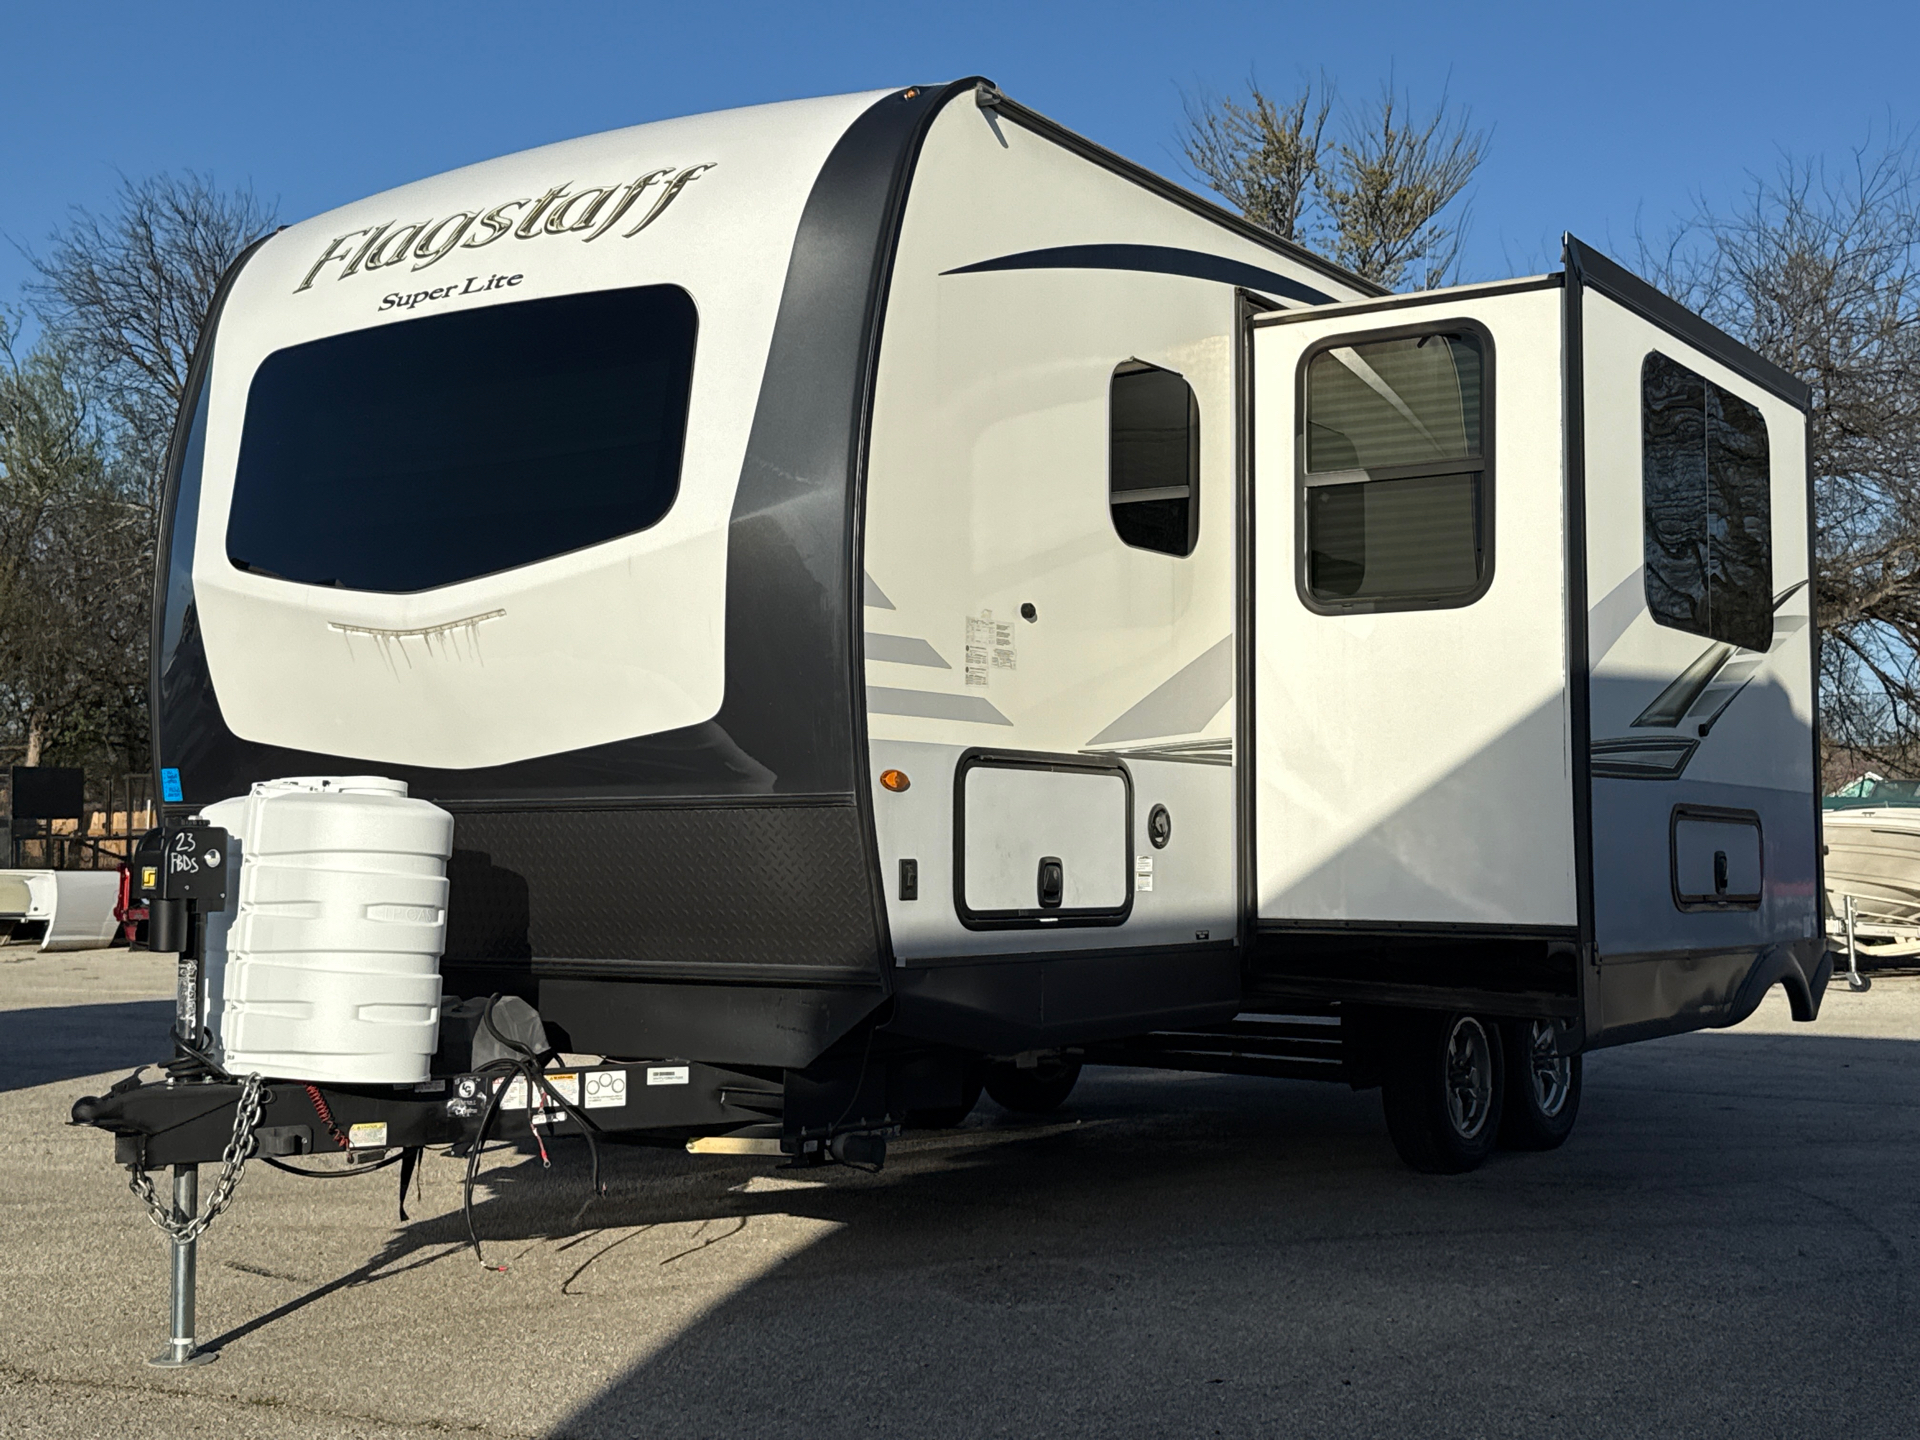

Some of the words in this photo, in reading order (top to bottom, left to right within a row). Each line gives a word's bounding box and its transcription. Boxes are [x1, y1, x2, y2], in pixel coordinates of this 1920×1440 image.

[292, 161, 718, 295] Flagstaff
[377, 284, 459, 312] Super
[458, 273, 524, 296] Lite
[175, 832, 196, 852] 23
[170, 852, 199, 874] FBDS
